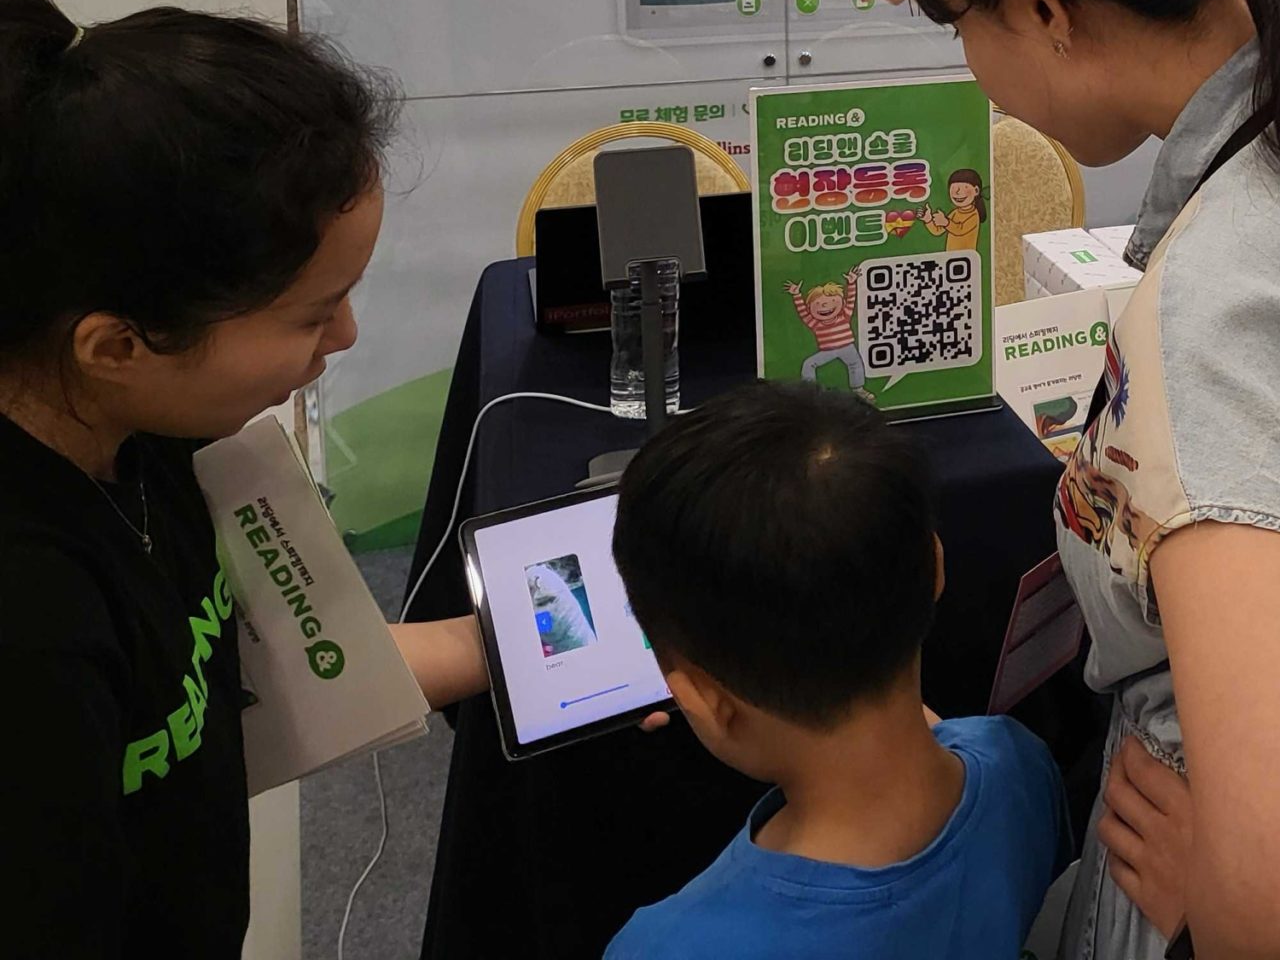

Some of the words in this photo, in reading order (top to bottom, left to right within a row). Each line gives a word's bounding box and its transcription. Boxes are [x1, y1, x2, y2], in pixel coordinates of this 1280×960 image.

[655, 105, 688, 123] 체험
[694, 103, 725, 122] 문의
[785, 134, 862, 165] 리딩앤
[865, 129, 916, 159] 스쿨
[771, 160, 932, 213] 현장등록
[785, 210, 887, 252] 이벤트
[256, 496, 286, 538] 리딩에서
